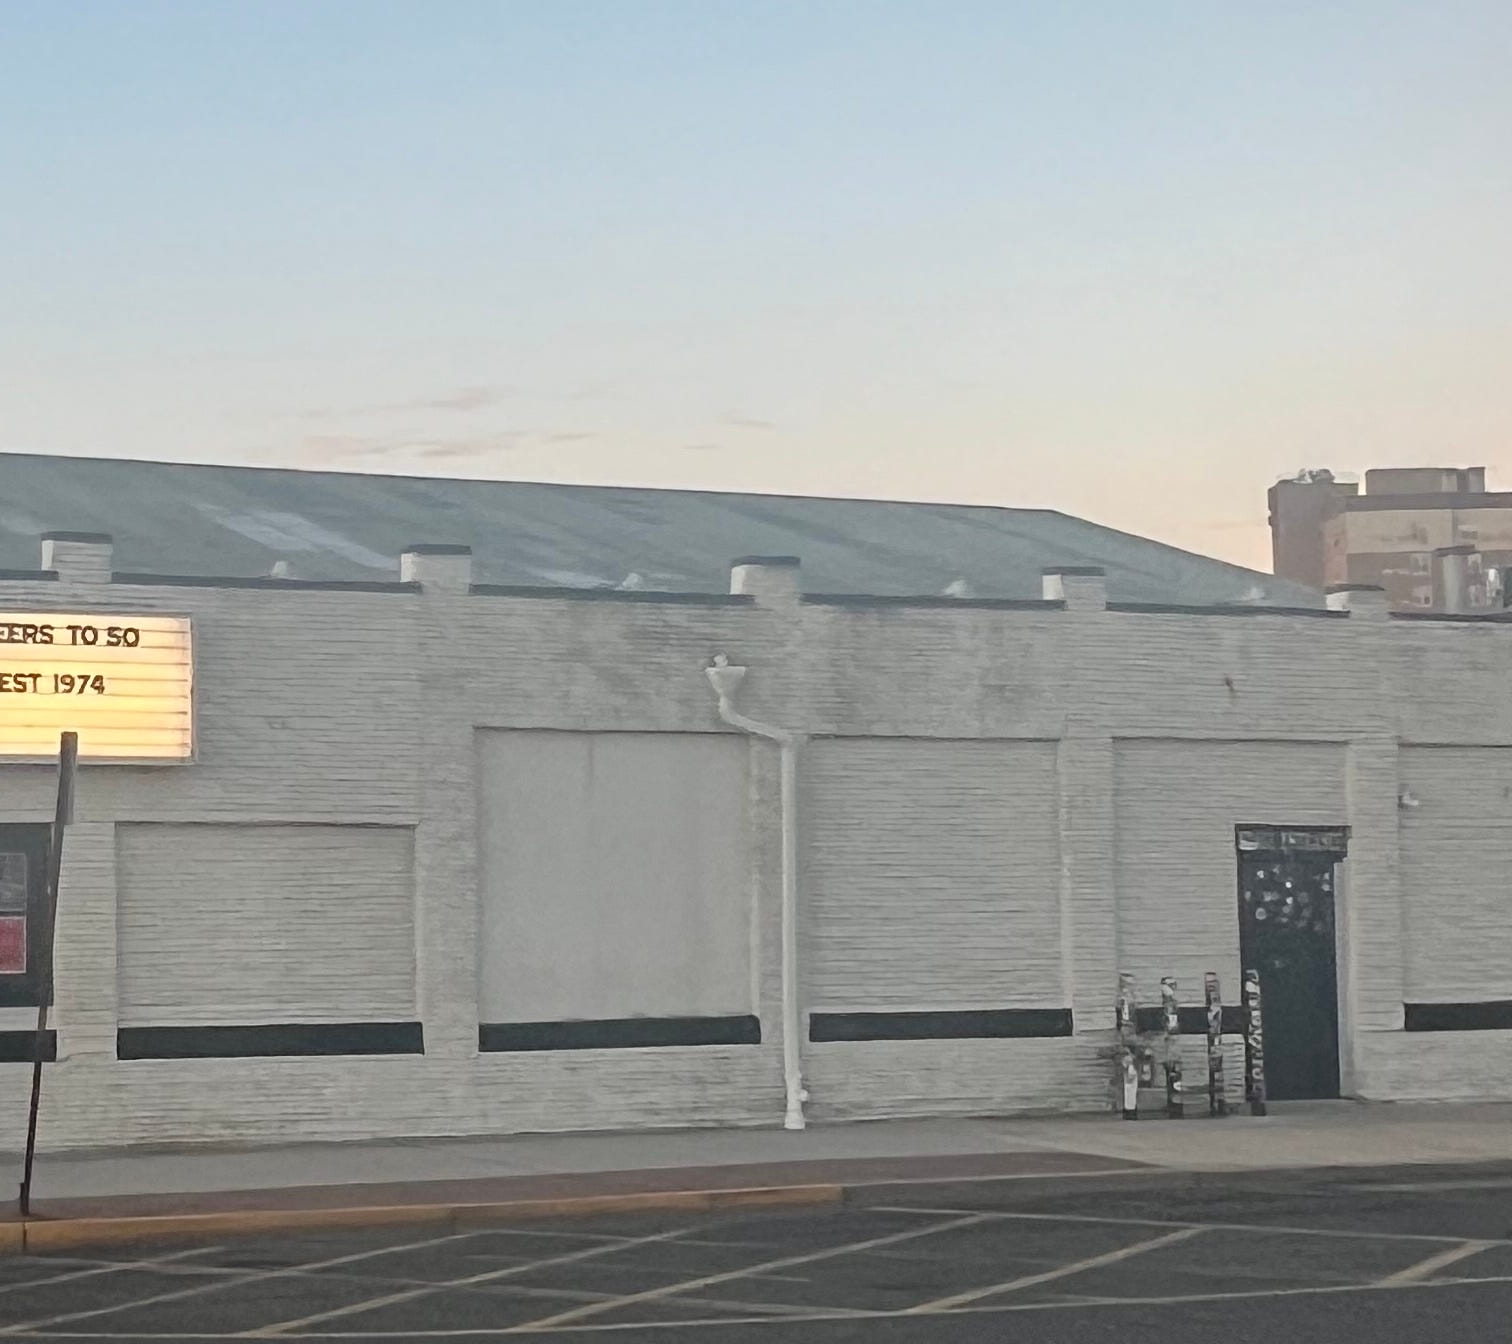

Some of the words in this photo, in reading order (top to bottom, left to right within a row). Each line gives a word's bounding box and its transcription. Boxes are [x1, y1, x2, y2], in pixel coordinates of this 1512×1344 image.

[67, 625, 98, 646] TO
[106, 626, 140, 648] 50
[54, 673, 106, 695] 1974
